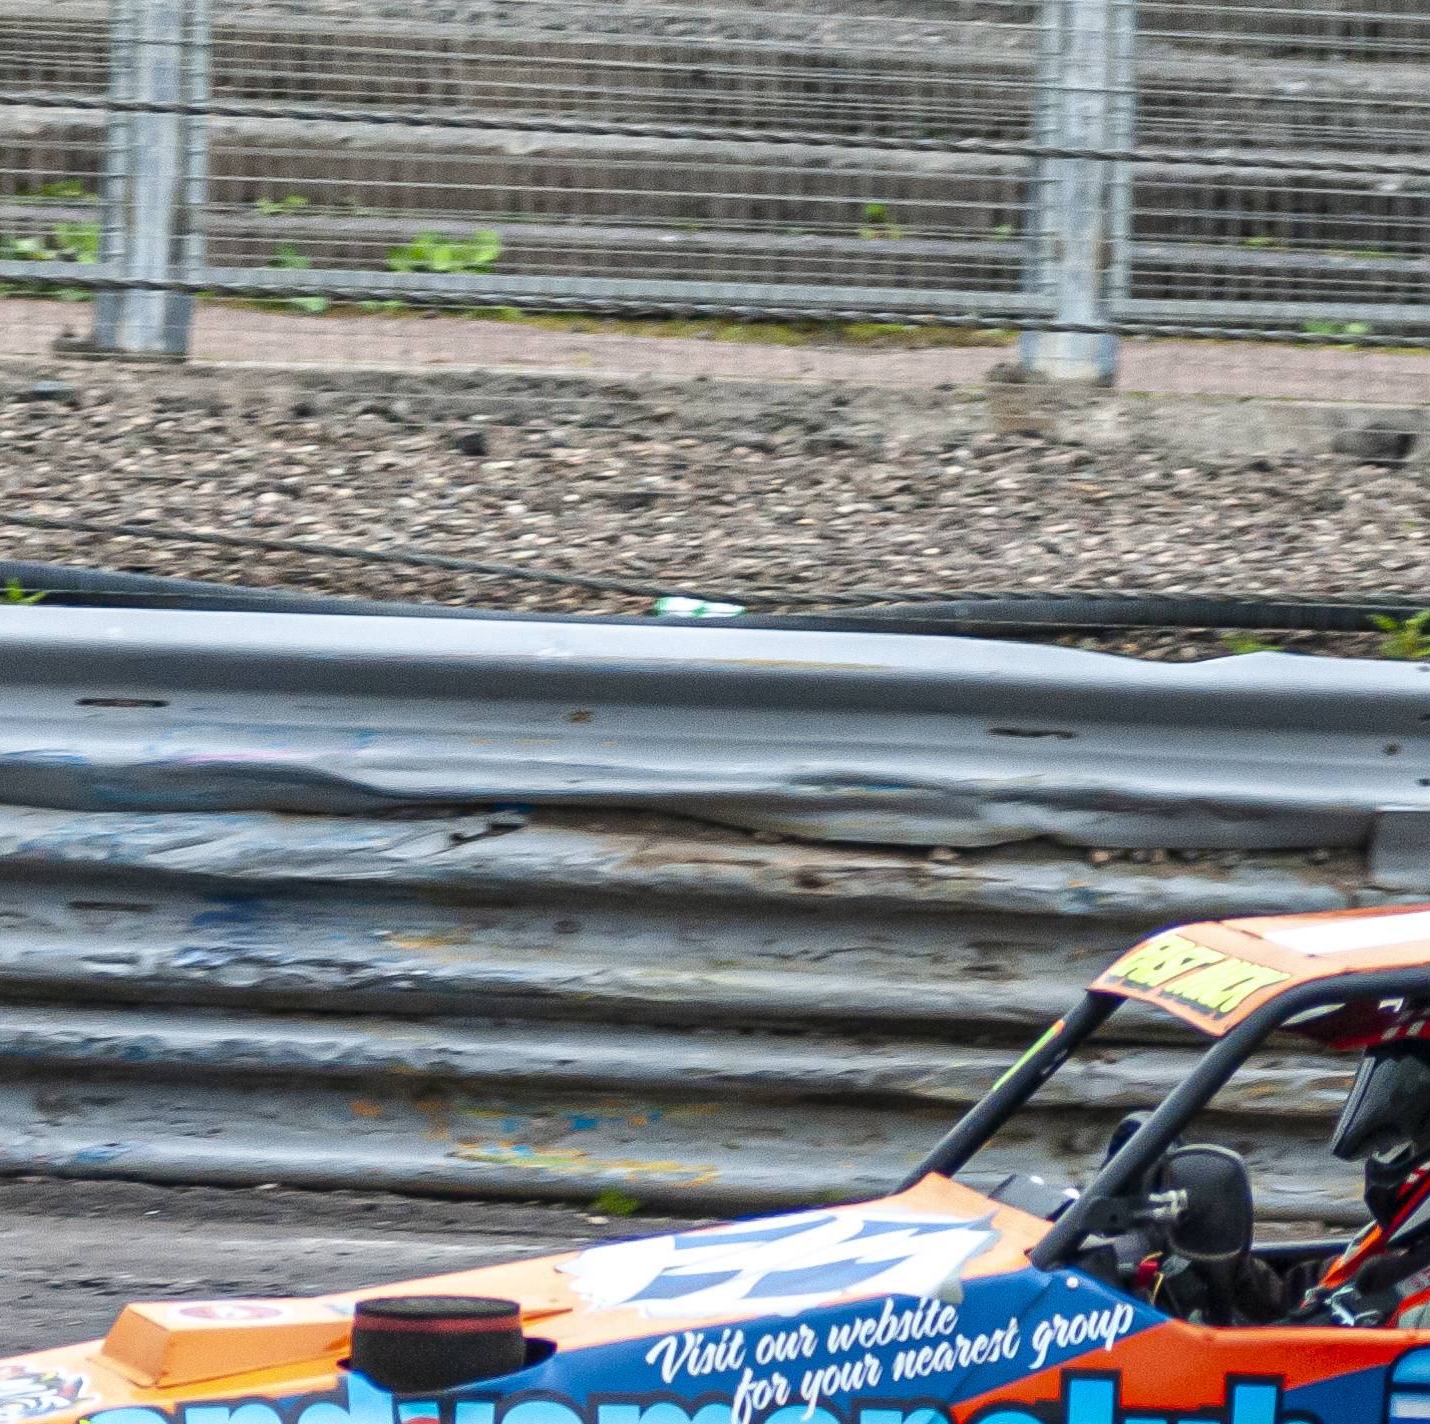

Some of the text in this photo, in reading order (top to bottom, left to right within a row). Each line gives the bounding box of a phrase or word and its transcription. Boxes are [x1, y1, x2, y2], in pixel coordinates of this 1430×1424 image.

[645, 1295, 959, 1385] Visit our website
[799, 1352, 884, 1421] your
[892, 1314, 1020, 1382] nearest
[1029, 1301, 1136, 1371] group
